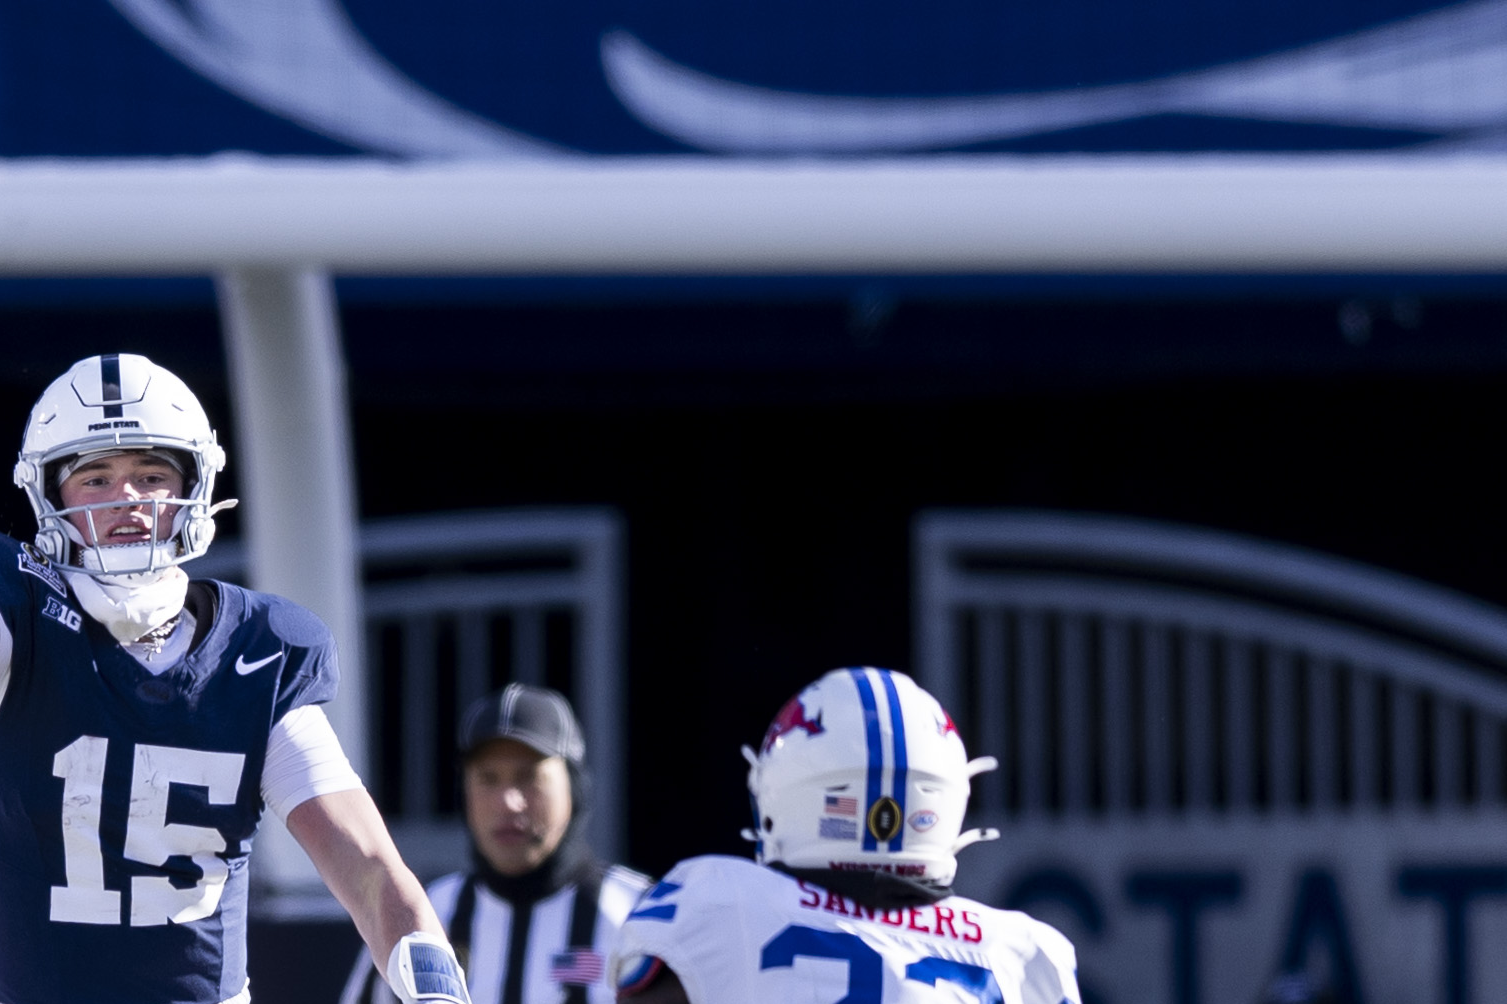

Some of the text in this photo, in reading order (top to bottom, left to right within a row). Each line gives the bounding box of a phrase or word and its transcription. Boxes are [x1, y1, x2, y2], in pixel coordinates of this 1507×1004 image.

[88, 420, 140, 432] PENN STATE
[50, 735, 246, 927] 15
